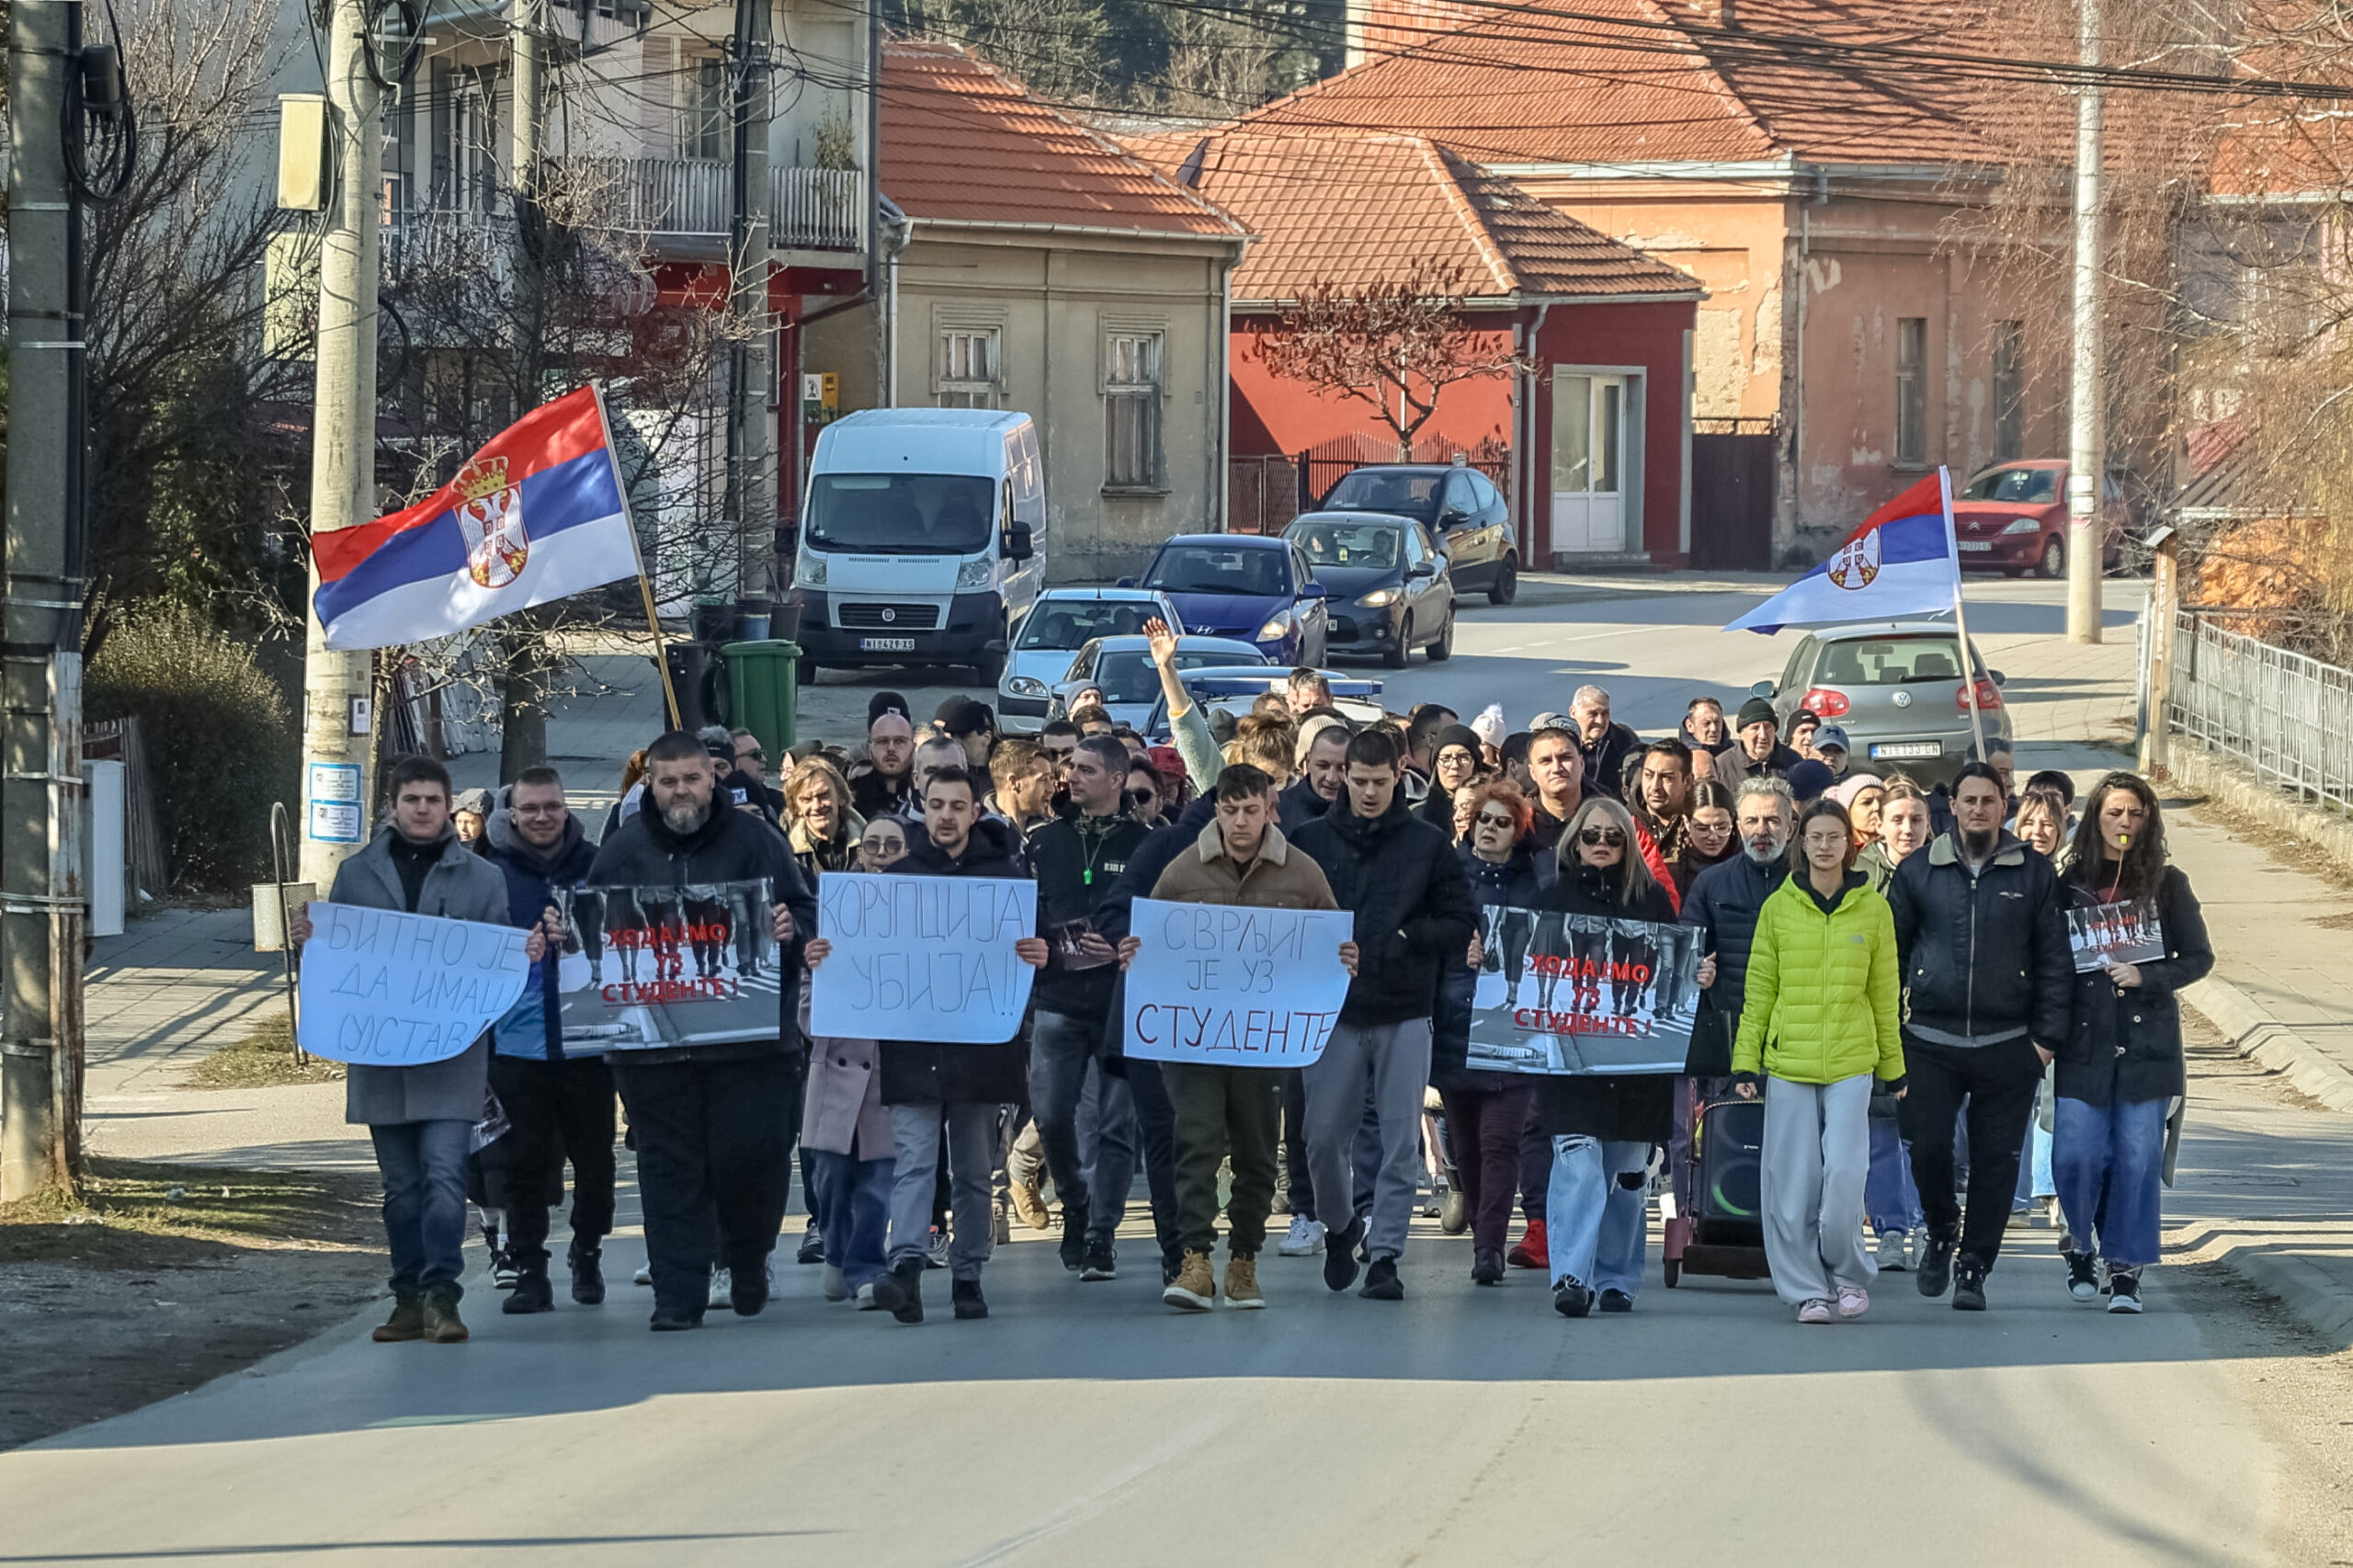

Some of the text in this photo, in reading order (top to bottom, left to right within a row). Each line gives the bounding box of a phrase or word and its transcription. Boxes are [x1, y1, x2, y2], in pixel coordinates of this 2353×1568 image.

[820, 880, 1026, 942] КОРУПЦИЈА
[329, 906, 529, 972] БИТНО ЈЕ
[607, 923, 728, 949] ХОДАЈМО
[1164, 908, 1324, 961] СВРЉИГ
[330, 962, 389, 1001] ДА
[1186, 958, 1275, 994] ЈЕ УЗ
[1529, 952, 1651, 983] ХОДАЈМО
[1572, 985, 1601, 1008] УЗ
[1135, 1003, 1339, 1054] СТУДЕНТЕ
